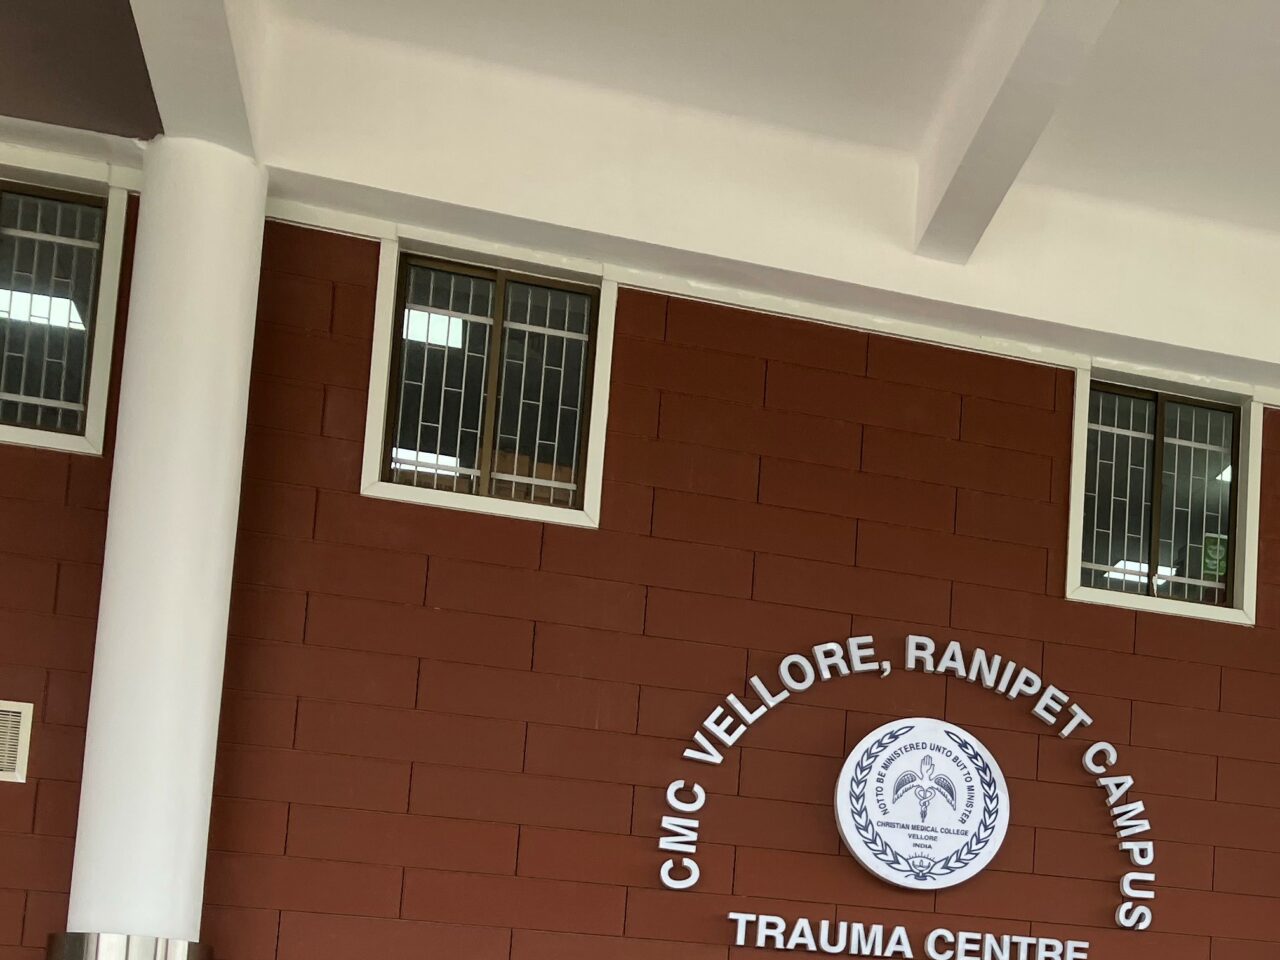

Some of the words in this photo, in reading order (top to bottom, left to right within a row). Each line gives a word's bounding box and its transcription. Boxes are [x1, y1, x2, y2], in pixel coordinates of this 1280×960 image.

[904, 634, 1095, 739] RANIPET
[682, 635, 893, 766] VELLORE,
[881, 742, 928, 771] MINISTERED
[929, 742, 953, 758] UNTO
[951, 755, 968, 771] BUT
[876, 770, 887, 784] BE
[963, 770, 973, 783] TO
[875, 786, 884, 797] TO
[876, 799, 890, 816] NOT
[958, 785, 975, 825] MINISTER
[659, 778, 707, 889] CMC
[876, 820, 910, 831] CHRISTIAN
[911, 824, 939, 833] MEDICAL
[940, 827, 969, 836] COLLEGE
[1081, 740, 1157, 932] CAMPUS
[908, 833, 938, 842] VELLORE
[727, 911, 914, 960] TRAUMA
